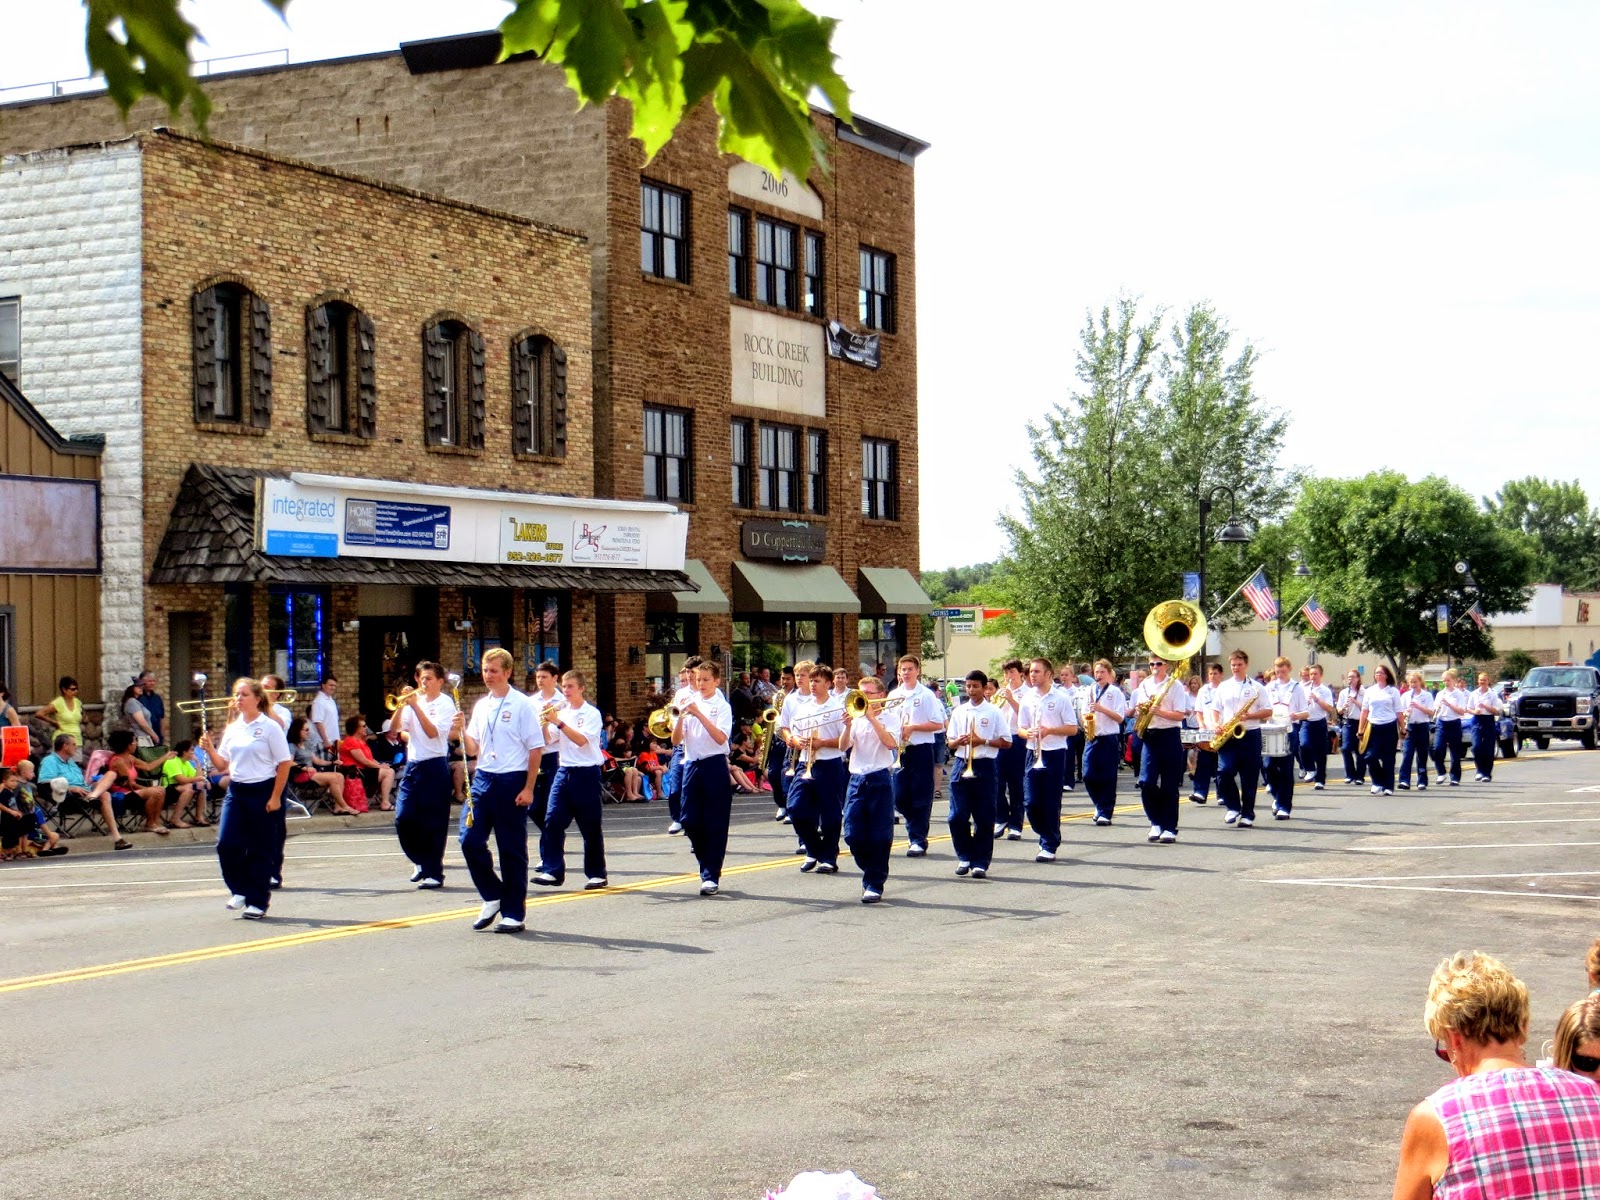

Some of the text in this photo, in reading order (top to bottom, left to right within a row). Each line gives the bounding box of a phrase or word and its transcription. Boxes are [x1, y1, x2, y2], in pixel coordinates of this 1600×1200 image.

[762, 171, 788, 197] 2006
[744, 333, 774, 356] ROCK
[777, 341, 809, 363] CREEK
[752, 362, 803, 388] BUILDING
[272, 494, 336, 521] integrated
[350, 506, 374, 518] HOME
[358, 519, 374, 528] TIME
[514, 522, 548, 542] LAKERS
[545, 542, 563, 550] STORE
[751, 531, 760, 546] D
[507, 551, 563, 563] 952-226-1677
